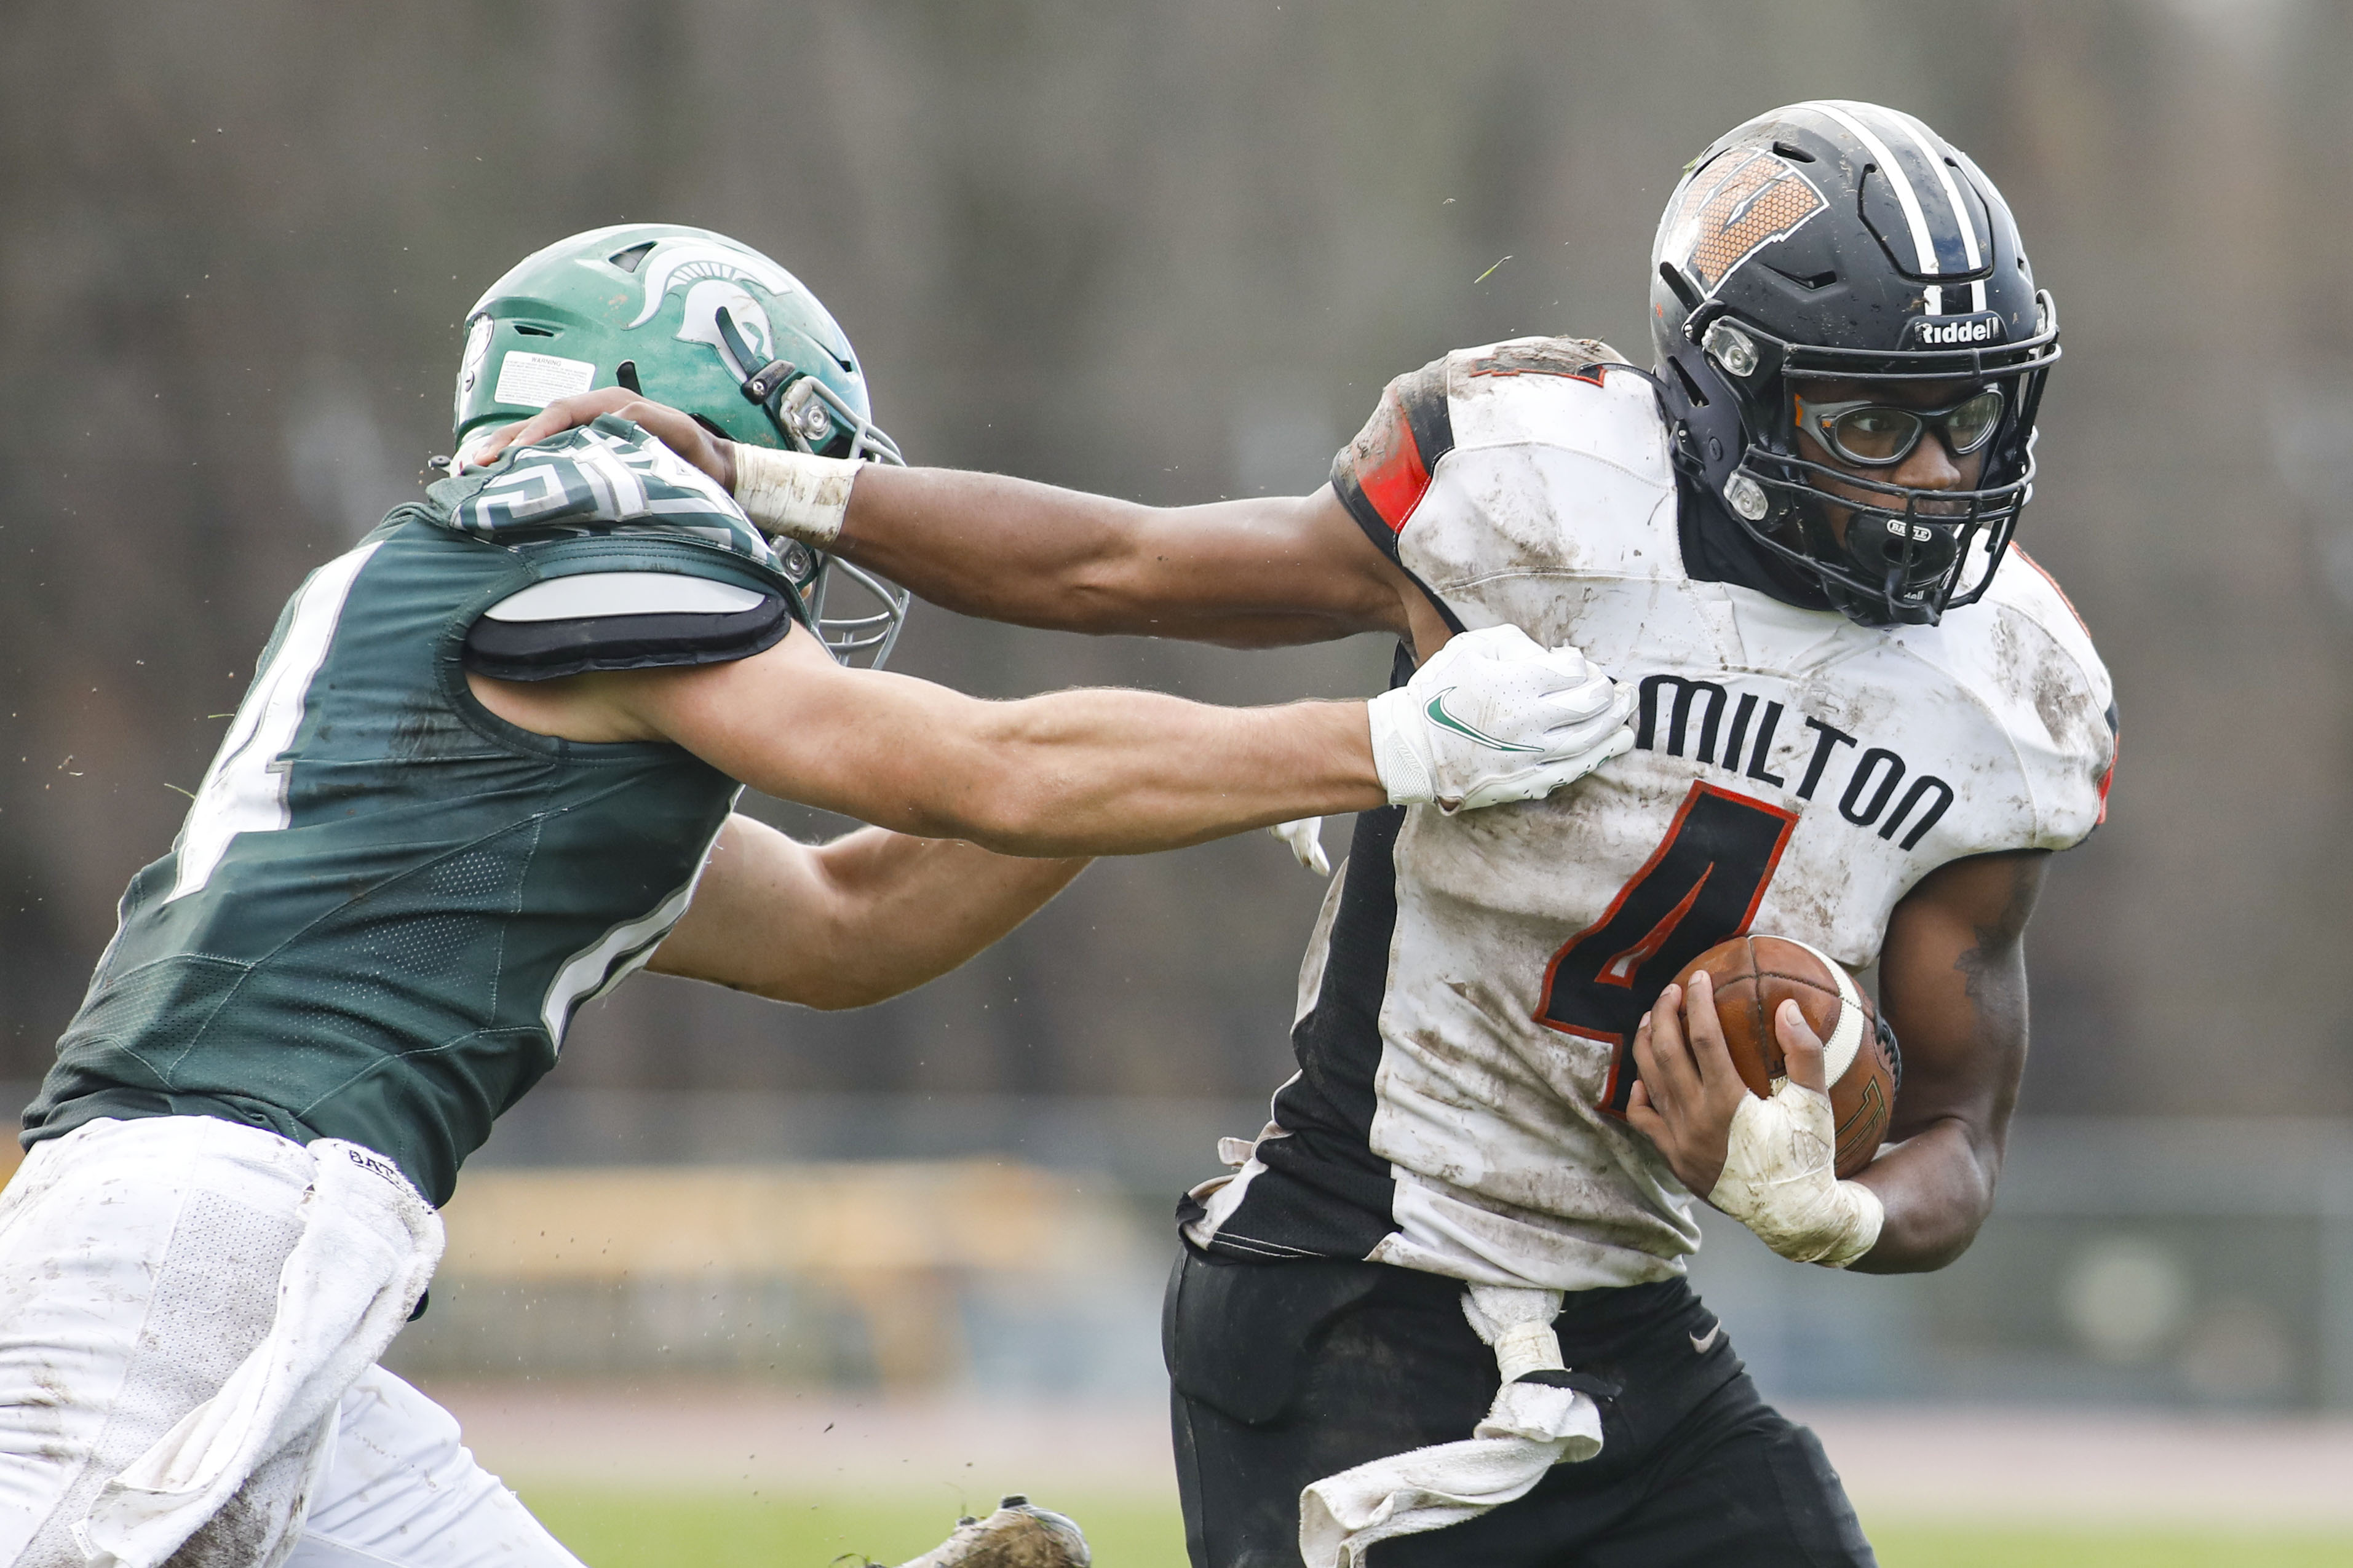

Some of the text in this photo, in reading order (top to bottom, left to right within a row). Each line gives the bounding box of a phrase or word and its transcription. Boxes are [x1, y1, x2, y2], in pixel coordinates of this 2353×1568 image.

[1914, 317, 1999, 344] Riddell
[531, 357, 561, 366] WARNING
[1891, 522, 1928, 539] BALE
[1609, 674, 1954, 852] MILTON
[1533, 779, 1799, 1121] 4
